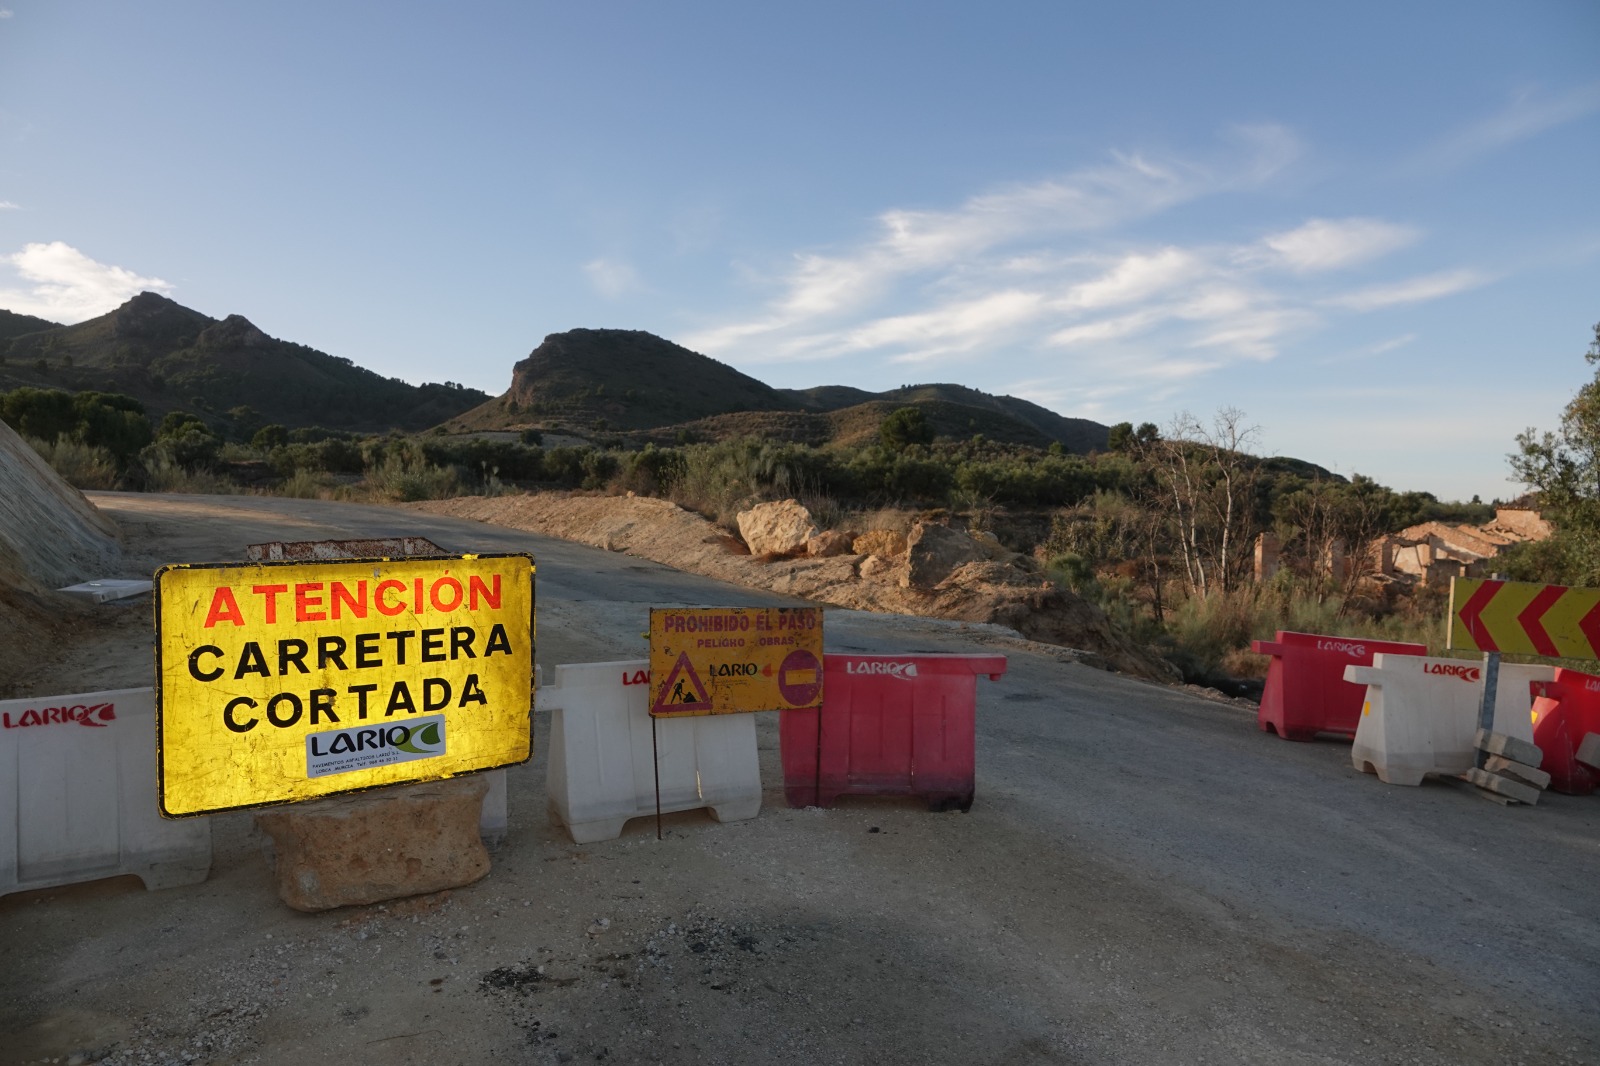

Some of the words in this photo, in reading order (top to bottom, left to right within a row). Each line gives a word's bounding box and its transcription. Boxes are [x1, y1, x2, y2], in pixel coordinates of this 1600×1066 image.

[203, 570, 501, 629] ATENCIÓN
[664, 614, 750, 633] PROHIBIDO
[756, 614, 772, 631] EL
[778, 612, 816, 631] PASO
[188, 623, 513, 683] CARRETERA
[759, 636, 795, 647] OBRAS
[622, 670, 651, 686] LA
[709, 663, 758, 677] LARIO
[223, 673, 488, 733] CORTADA
[3, 704, 89, 729] LARIO
[311, 725, 411, 757] LARIO
[312, 759, 345, 768] PAVIMENTOS
